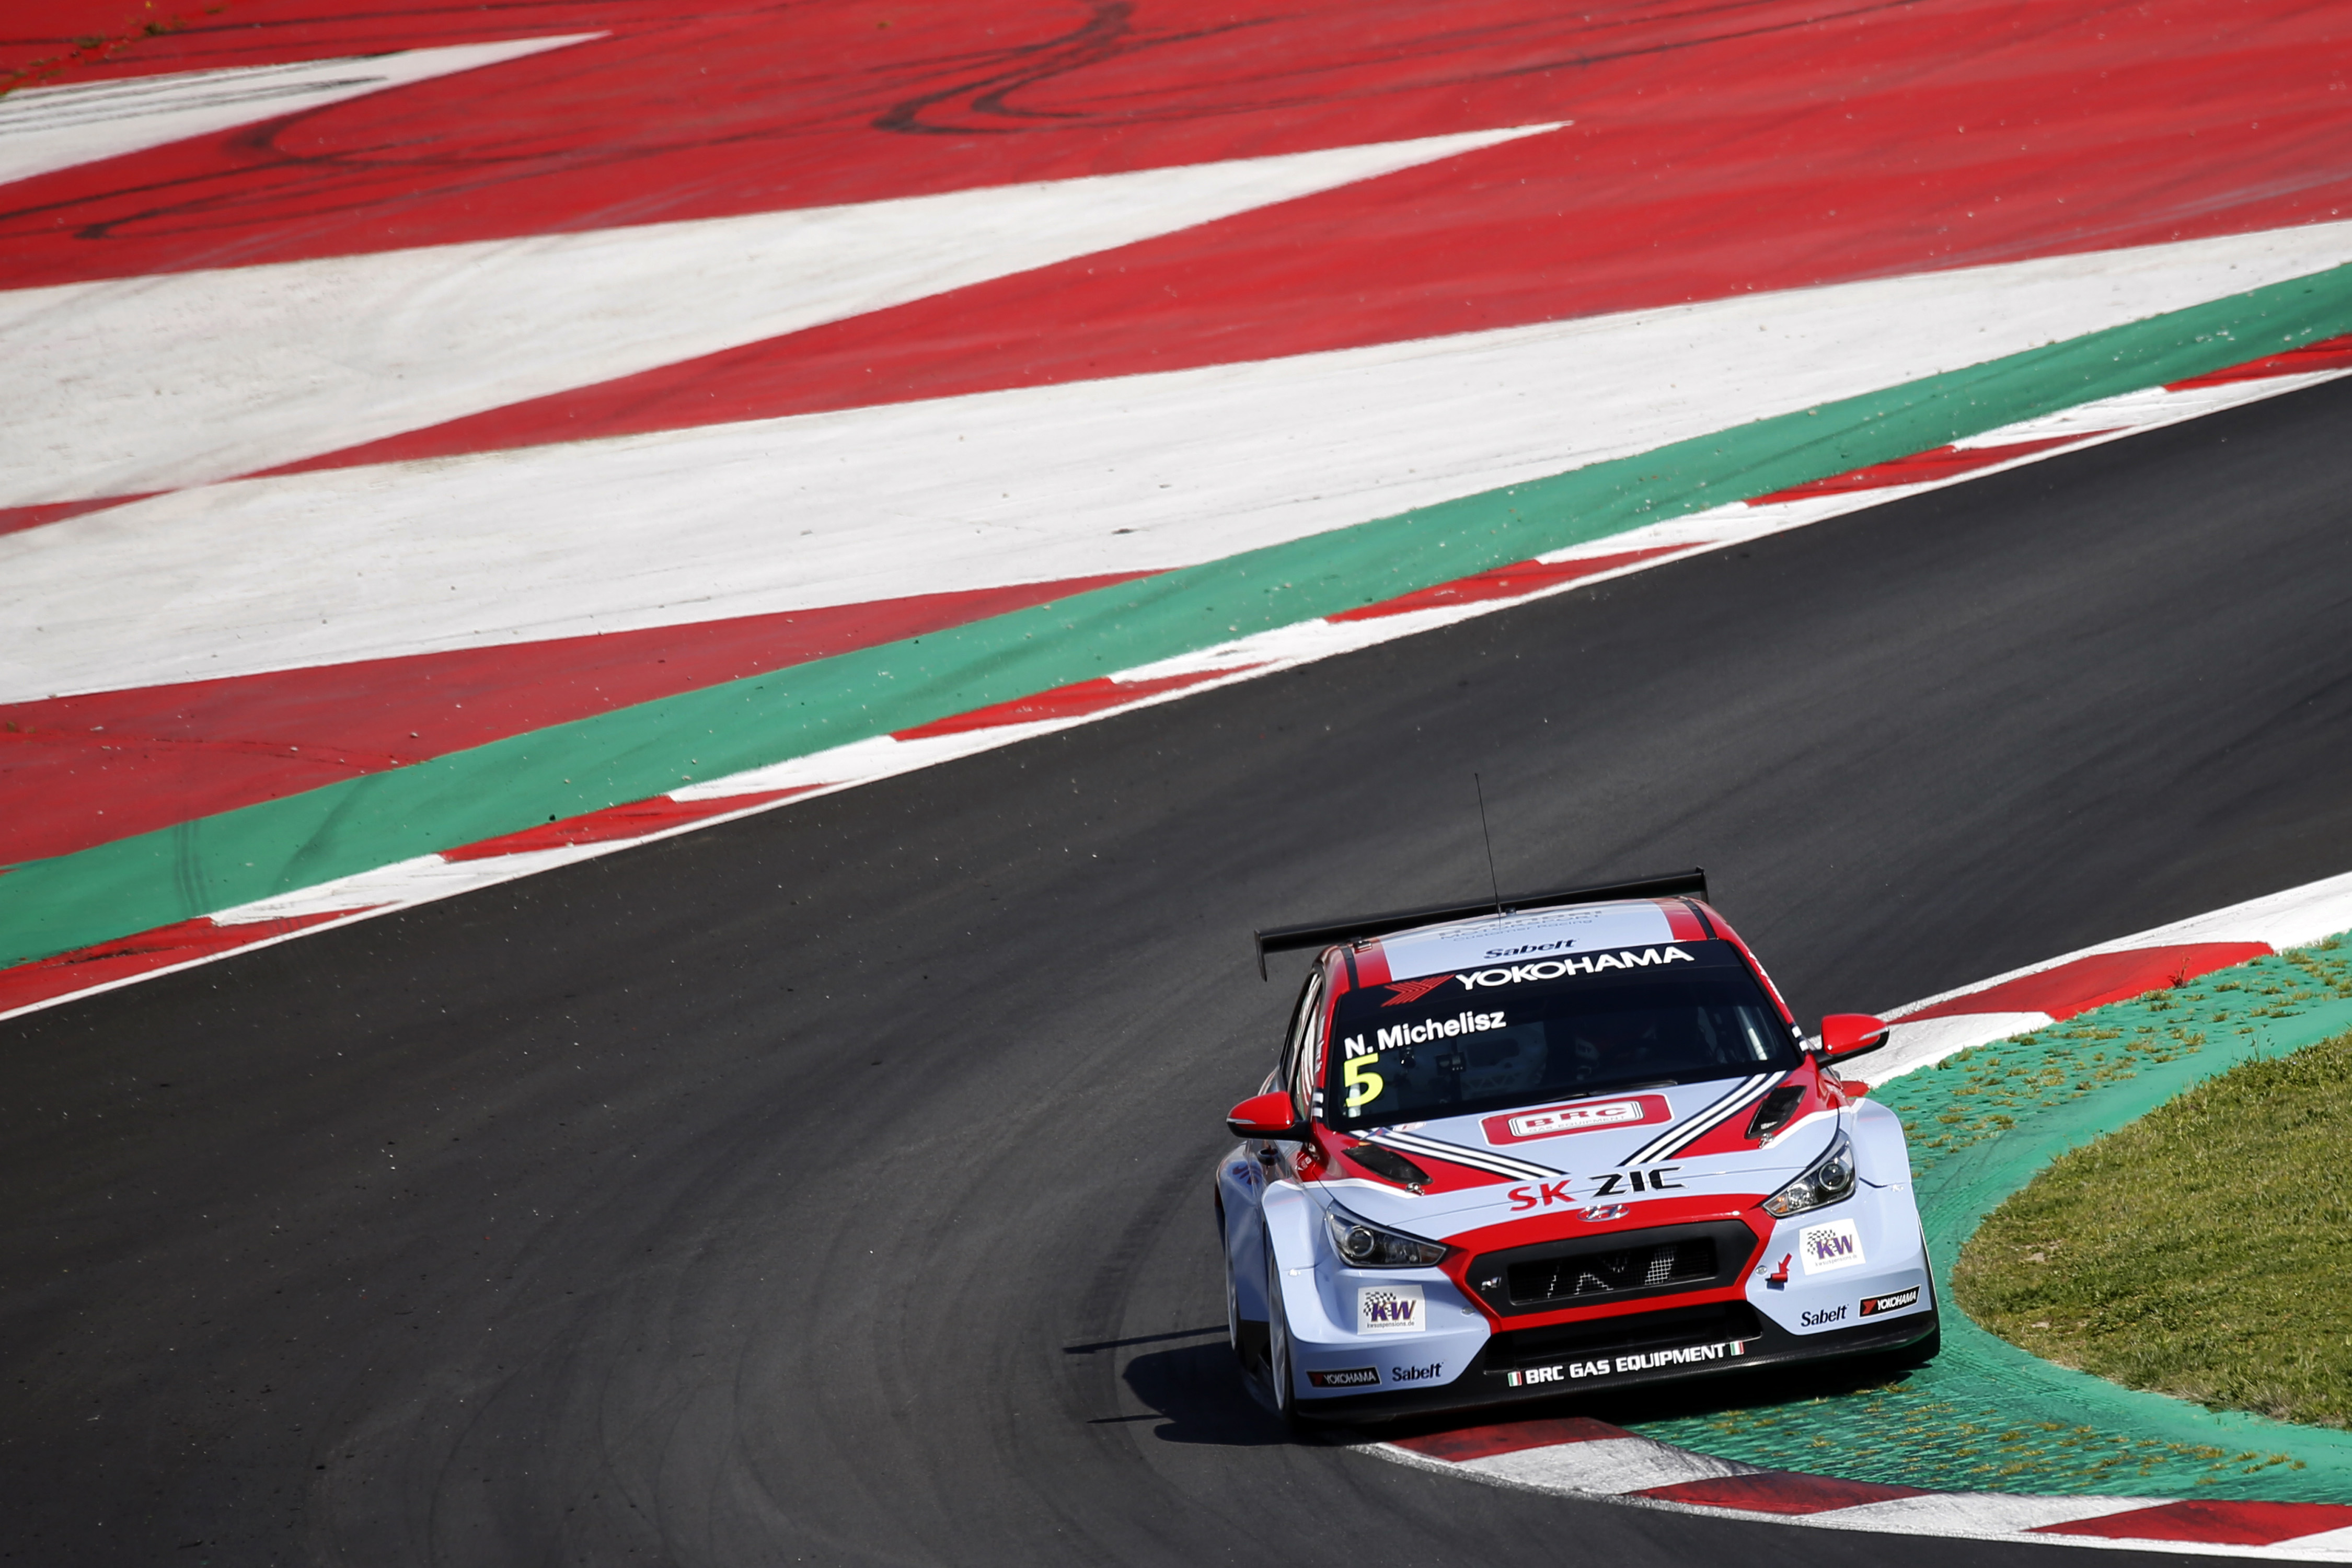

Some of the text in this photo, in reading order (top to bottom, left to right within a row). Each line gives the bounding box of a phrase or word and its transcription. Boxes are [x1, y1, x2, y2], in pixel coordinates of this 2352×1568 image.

[1483, 939, 1577, 959] Sabelt
[1455, 947, 1695, 990] YOKOHAMA
[1344, 1034, 1373, 1059] N.
[1377, 1011, 1506, 1051] Michelisz
[1343, 1053, 1383, 1108] 5
[1525, 1107, 1628, 1128] BRC
[1507, 1166, 1689, 1212] SK ZIC
[1815, 1234, 1853, 1260] KW
[1371, 1299, 1416, 1322] KW
[1877, 1290, 1917, 1311] YOKOHAMA
[1800, 1304, 1848, 1327] Sabelt
[1392, 1363, 1442, 1382] Sabelt
[1525, 1343, 1726, 1385] BRC GAS EQUIPMENT
[1323, 1370, 1377, 1385] YOKOHAMA
